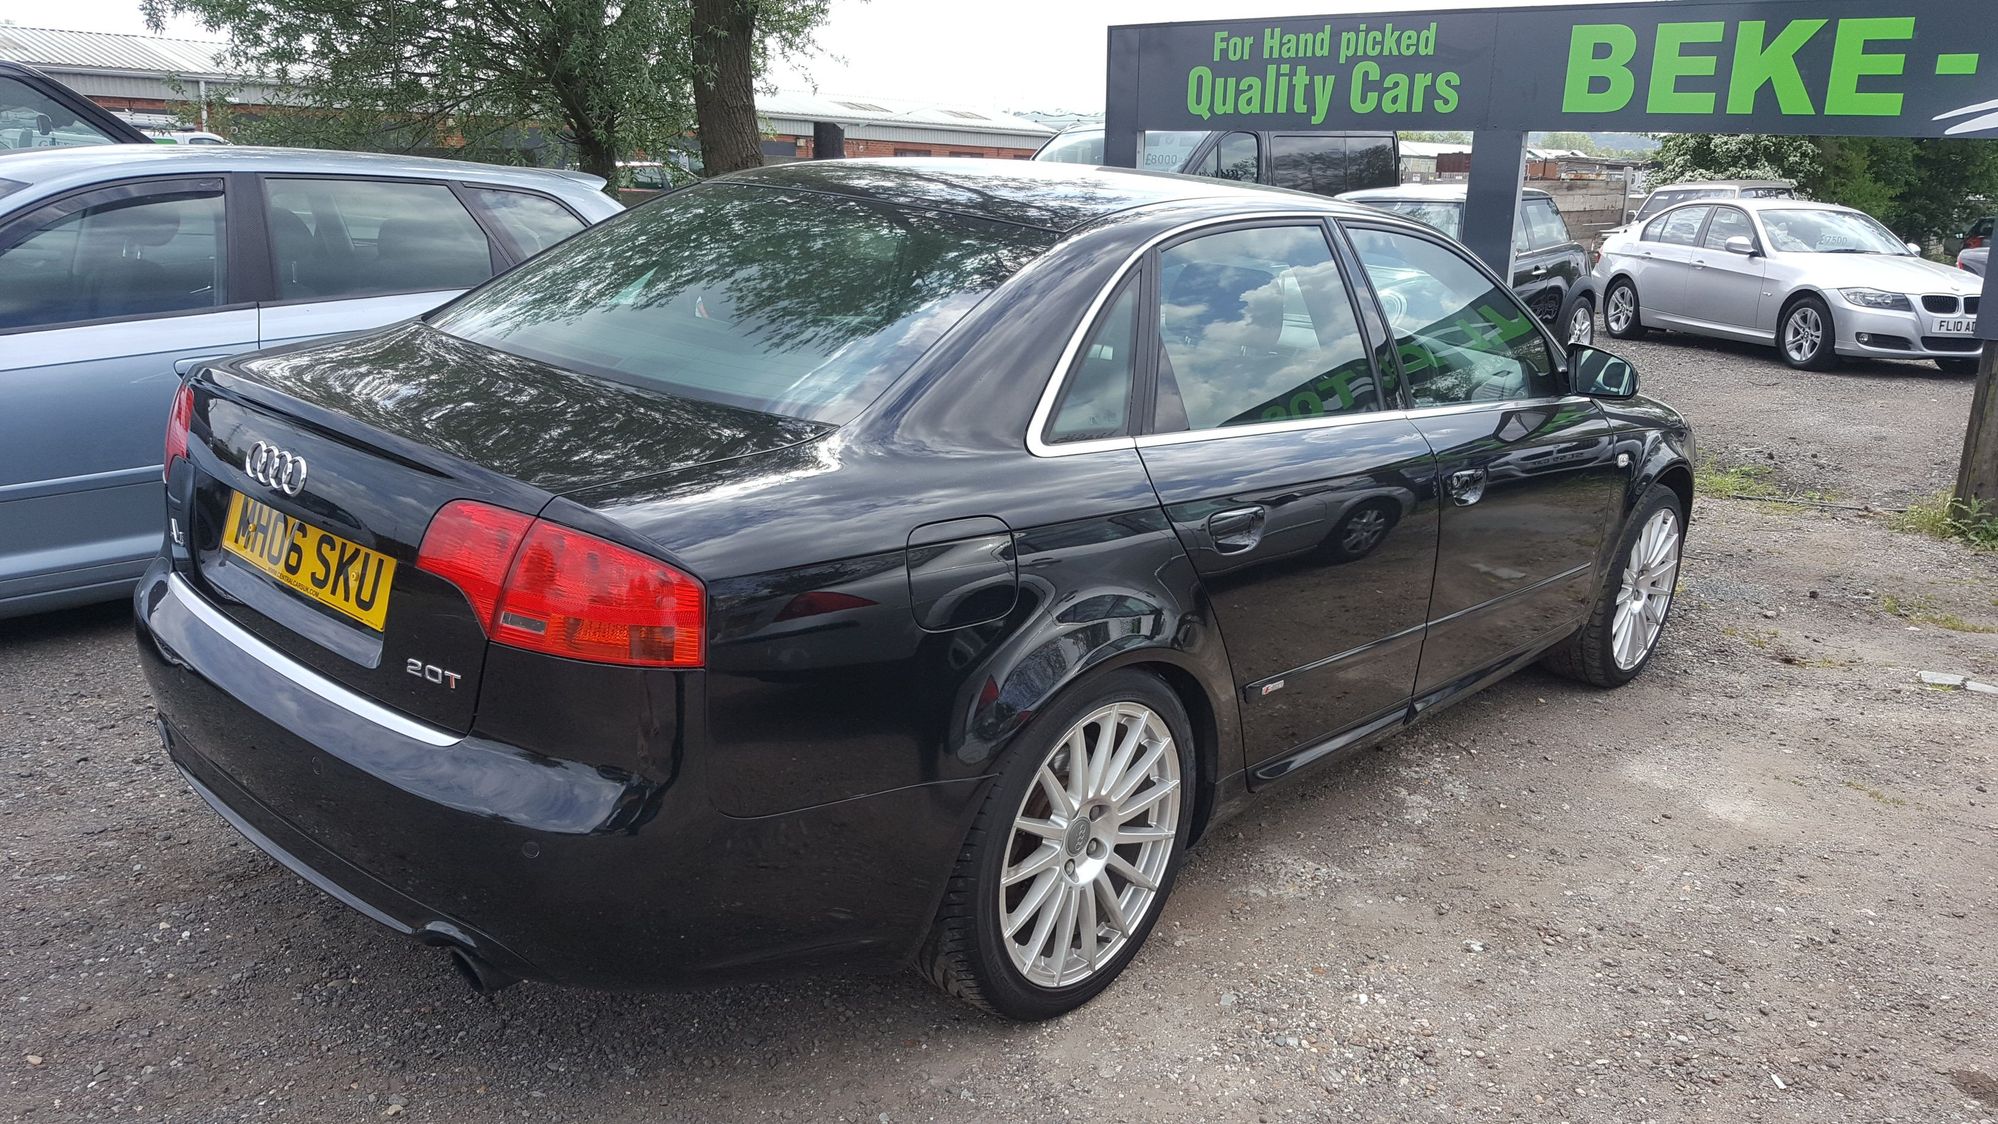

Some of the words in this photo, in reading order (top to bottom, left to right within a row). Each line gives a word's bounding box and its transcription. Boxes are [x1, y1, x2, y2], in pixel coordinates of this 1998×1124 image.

[1213, 31, 1254, 61] For
[1263, 25, 1331, 59] Hand
[1339, 22, 1437, 64] picked
[1187, 64, 1335, 125] Quality
[1350, 61, 1461, 113] Cars
[1145, 153, 1178, 165] £8000
[234, 495, 308, 576] MH06
[310, 533, 385, 612] SKU
